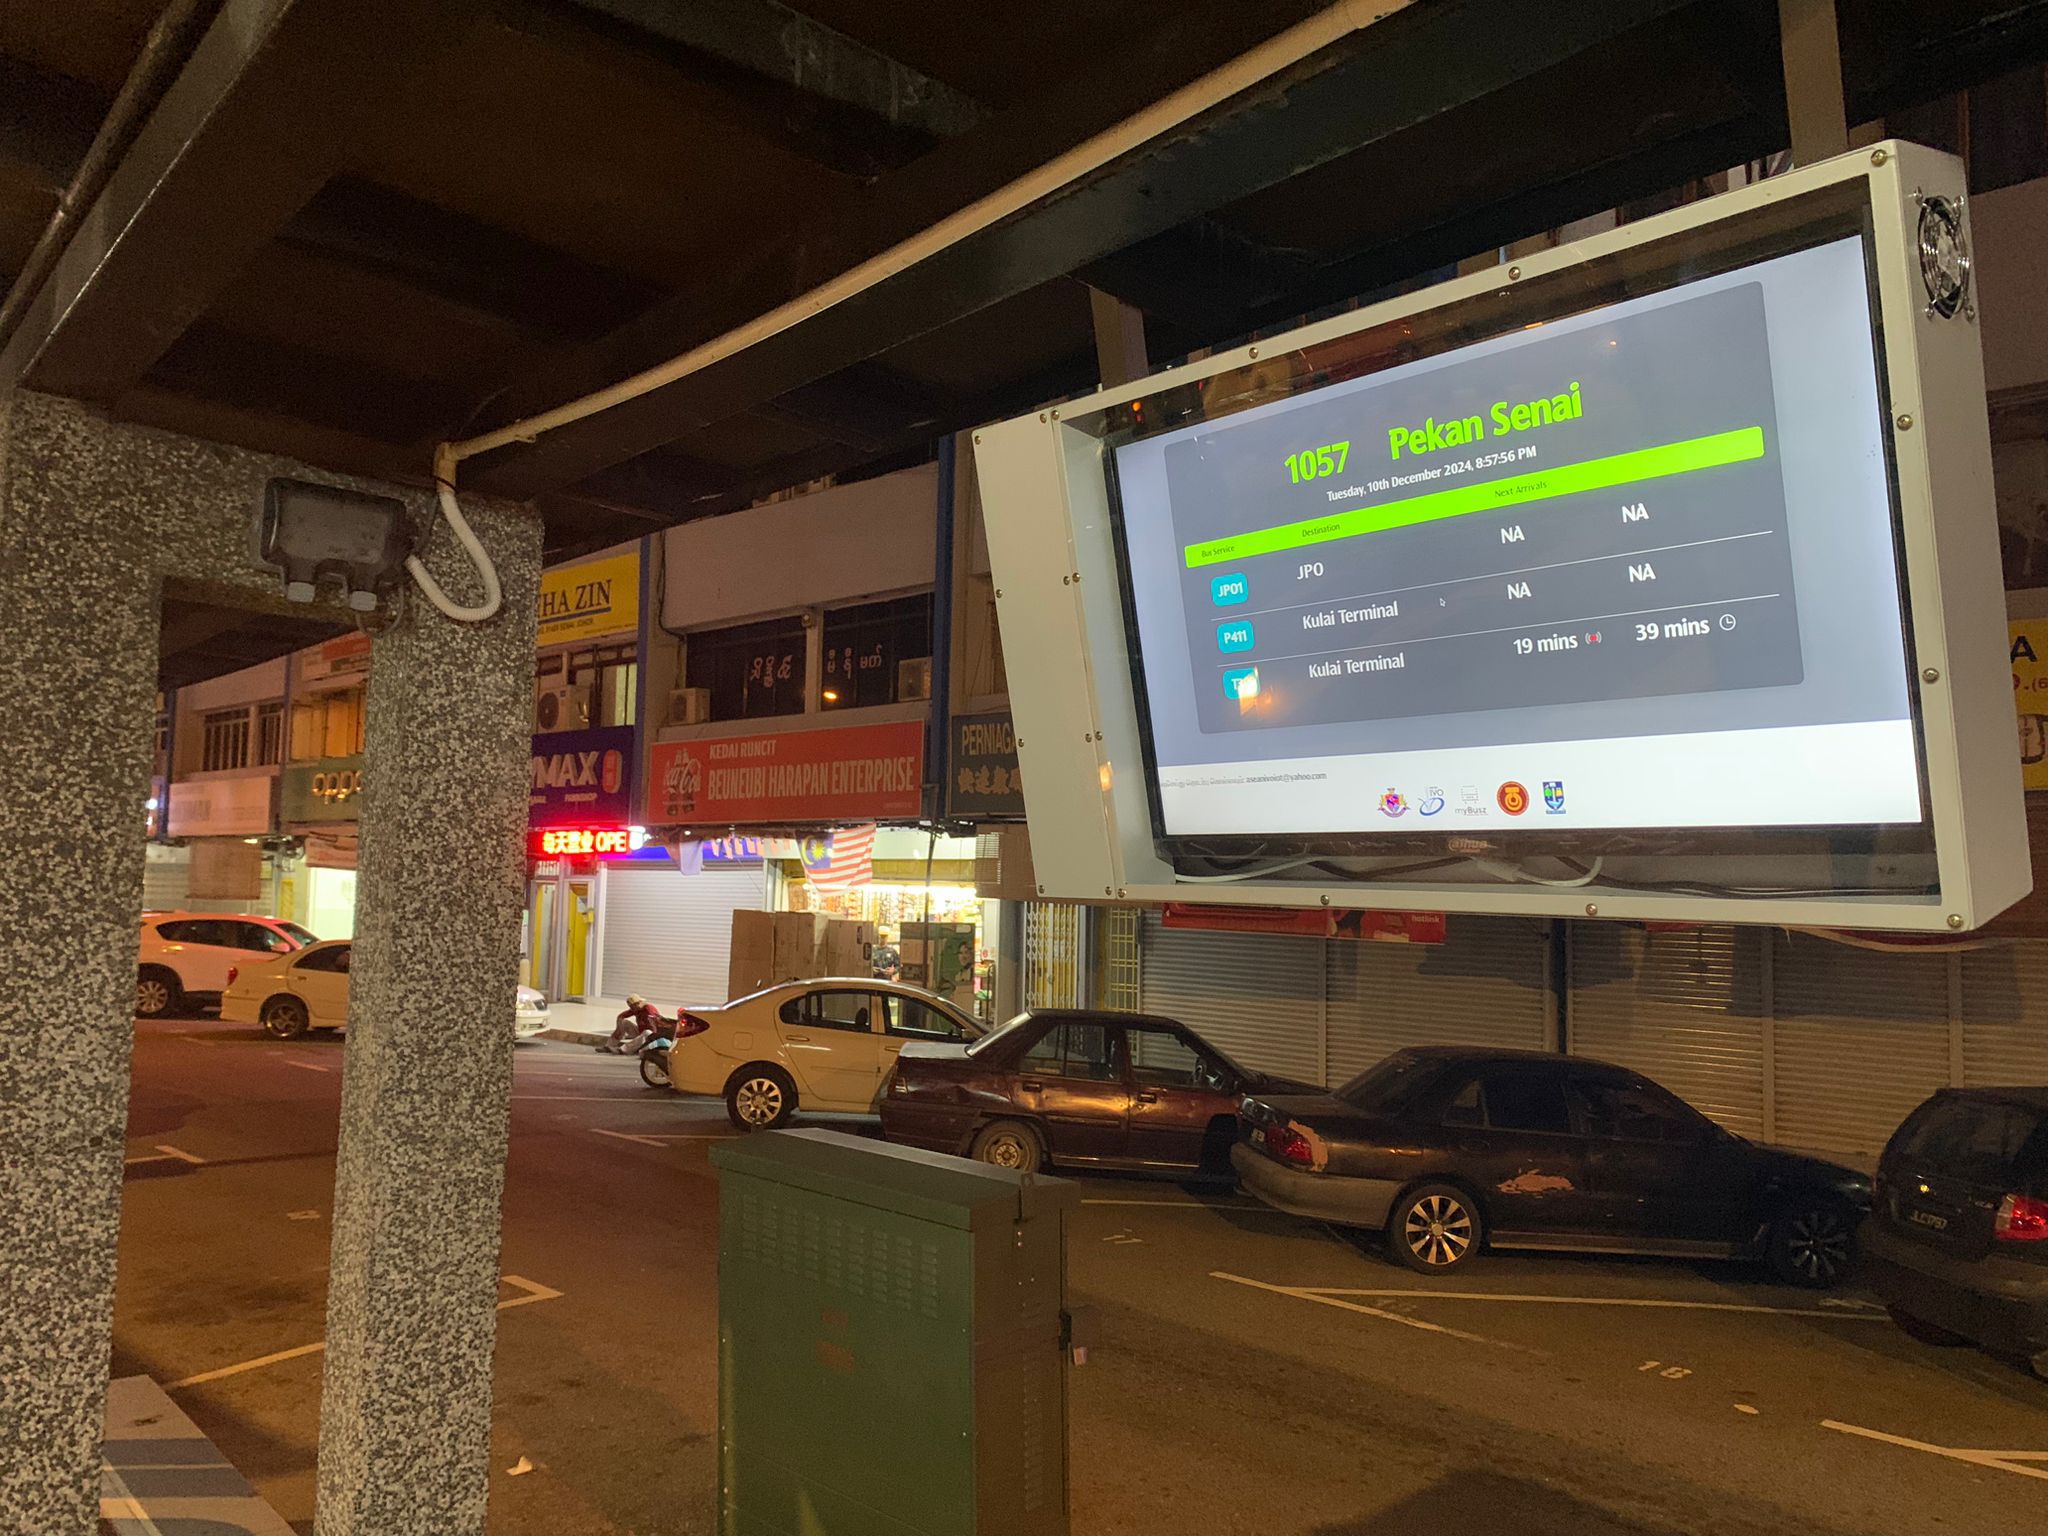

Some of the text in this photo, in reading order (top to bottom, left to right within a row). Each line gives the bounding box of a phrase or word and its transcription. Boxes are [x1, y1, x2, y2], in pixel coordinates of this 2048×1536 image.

[1284, 381, 1583, 484] 1057 Pekan Senai
[1326, 445, 1537, 502] Tuesday, 10th December 2024, 8:57:56 PM
[1494, 480, 1548, 498] Next Arrivals
[1621, 502, 1649, 523] NA
[1302, 522, 1340, 537] Destination
[1500, 525, 1525, 544] NA
[1201, 544, 1235, 558] Bus Service
[1296, 562, 1324, 580] JPO
[1628, 563, 1656, 583] NA
[538, 579, 612, 618] HA ZIN
[1507, 581, 1532, 600] NA
[1302, 600, 1399, 630] Kulai Terminal
[1223, 629, 1248, 645] P411
[1635, 618, 1710, 641] 39 mins
[1513, 633, 1578, 655] 19 mins
[1308, 652, 1405, 679] Kulai Terminal
[709, 739, 777, 760] KEDAI RUNCIT
[768, 761, 828, 798] HARAPAN
[831, 757, 915, 796] ENTERPRISE
